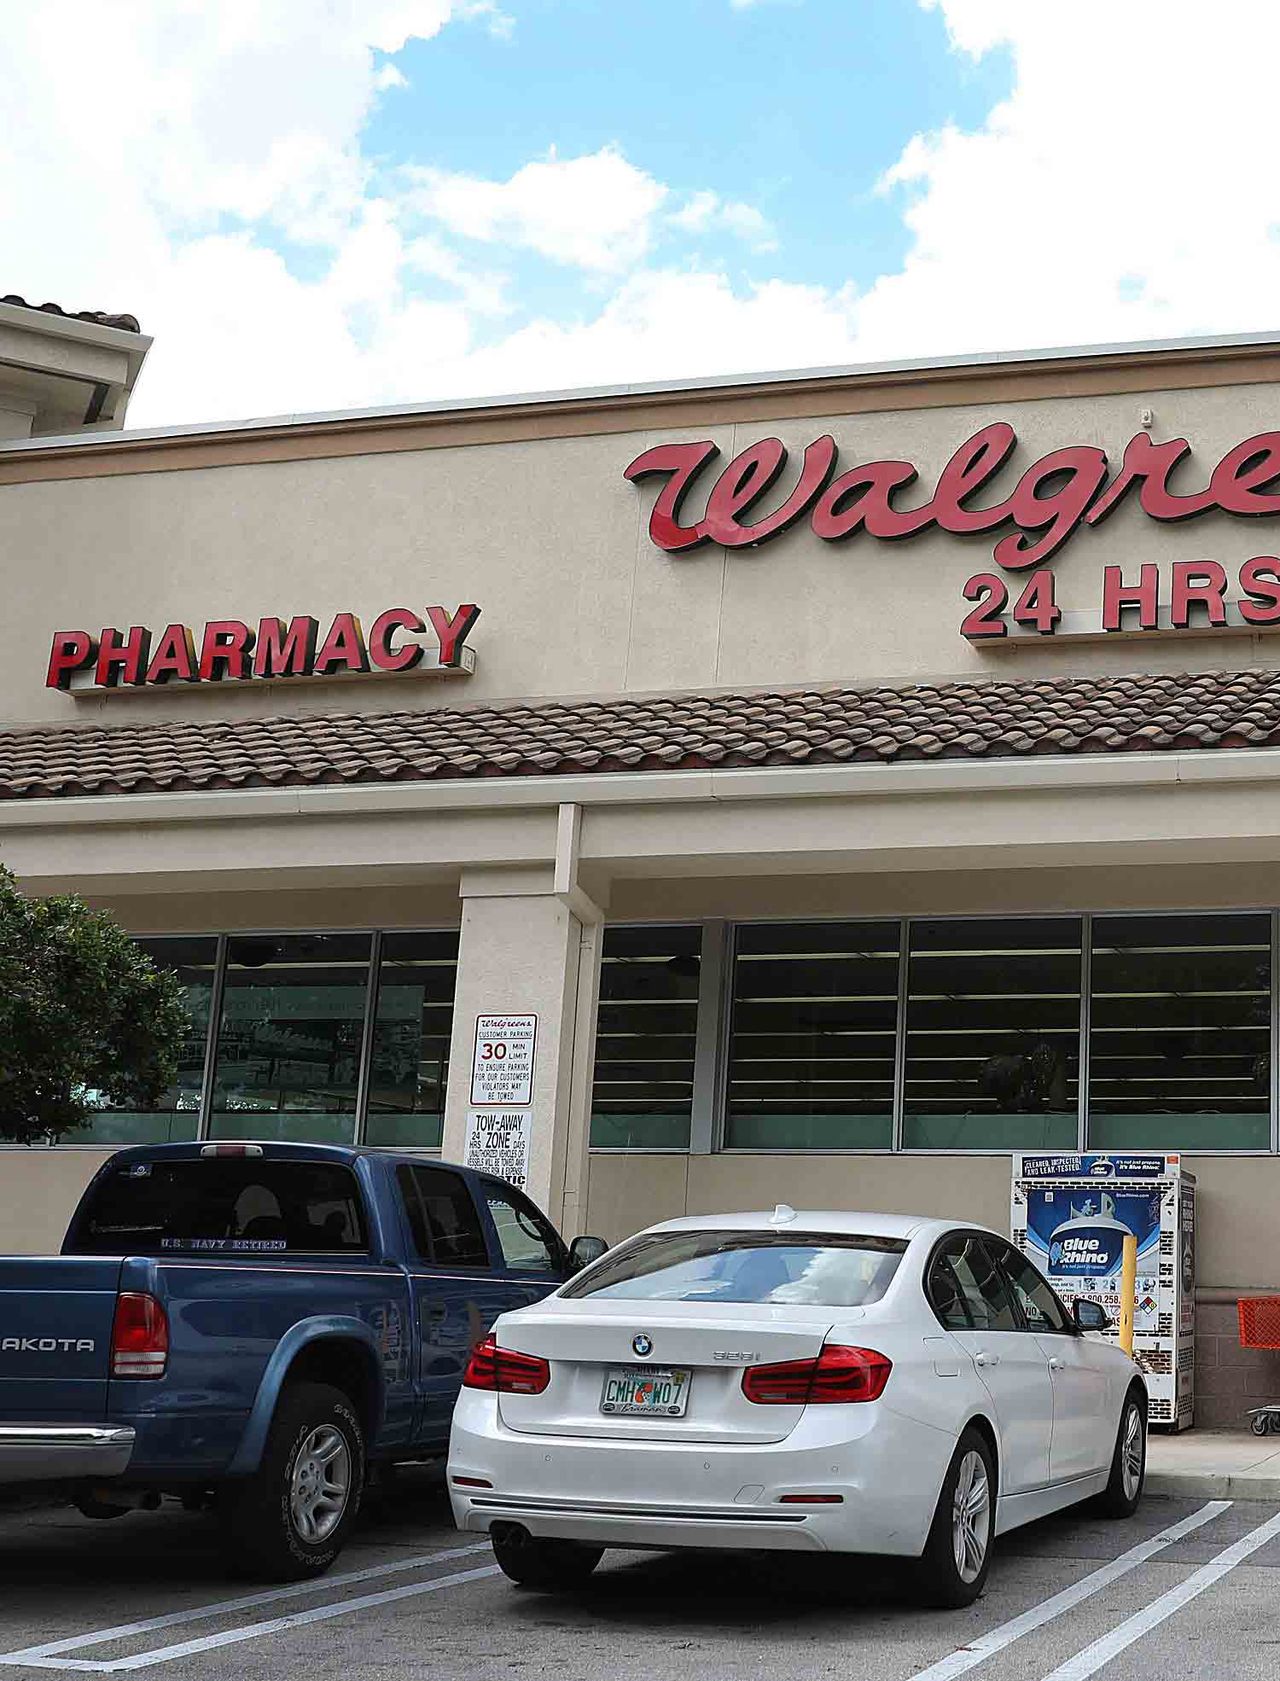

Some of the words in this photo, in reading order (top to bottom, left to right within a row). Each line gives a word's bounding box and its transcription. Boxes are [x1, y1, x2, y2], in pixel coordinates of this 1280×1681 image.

[960, 569, 1063, 638] 24
[46, 603, 482, 689] PHARMACY
[481, 1020, 532, 1029] Walgreens
[481, 1043, 506, 1060] 30
[477, 1063, 484, 1071] TO
[486, 1063, 506, 1071] ENSURE
[508, 1063, 529, 1071] PARKING
[475, 1073, 486, 1081] FOR
[487, 1073, 498, 1081] OUR
[500, 1073, 530, 1081] CUSTOMERS
[482, 1082, 510, 1091] VIOLATORS
[511, 1082, 522, 1090] MAY
[488, 1092, 495, 1100] BE
[497, 1092, 514, 1100] TOWED
[475, 1114, 524, 1131] TOW-AWAY
[471, 1131, 480, 1140] 24
[485, 1131, 511, 1148] ZONE
[518, 1131, 523, 1140] 7
[469, 1140, 482, 1149] HRS
[512, 1140, 526, 1149] DAYS
[1027, 1168, 1039, 1176] AND
[161, 1239, 184, 1248] U.S.
[191, 1239, 226, 1249] NAVY
[232, 1240, 287, 1250] RETIRED
[1064, 1238, 1099, 1250] Blue
[1060, 1251, 1108, 1263] Rhino
[607, 1380, 635, 1402] CMH
